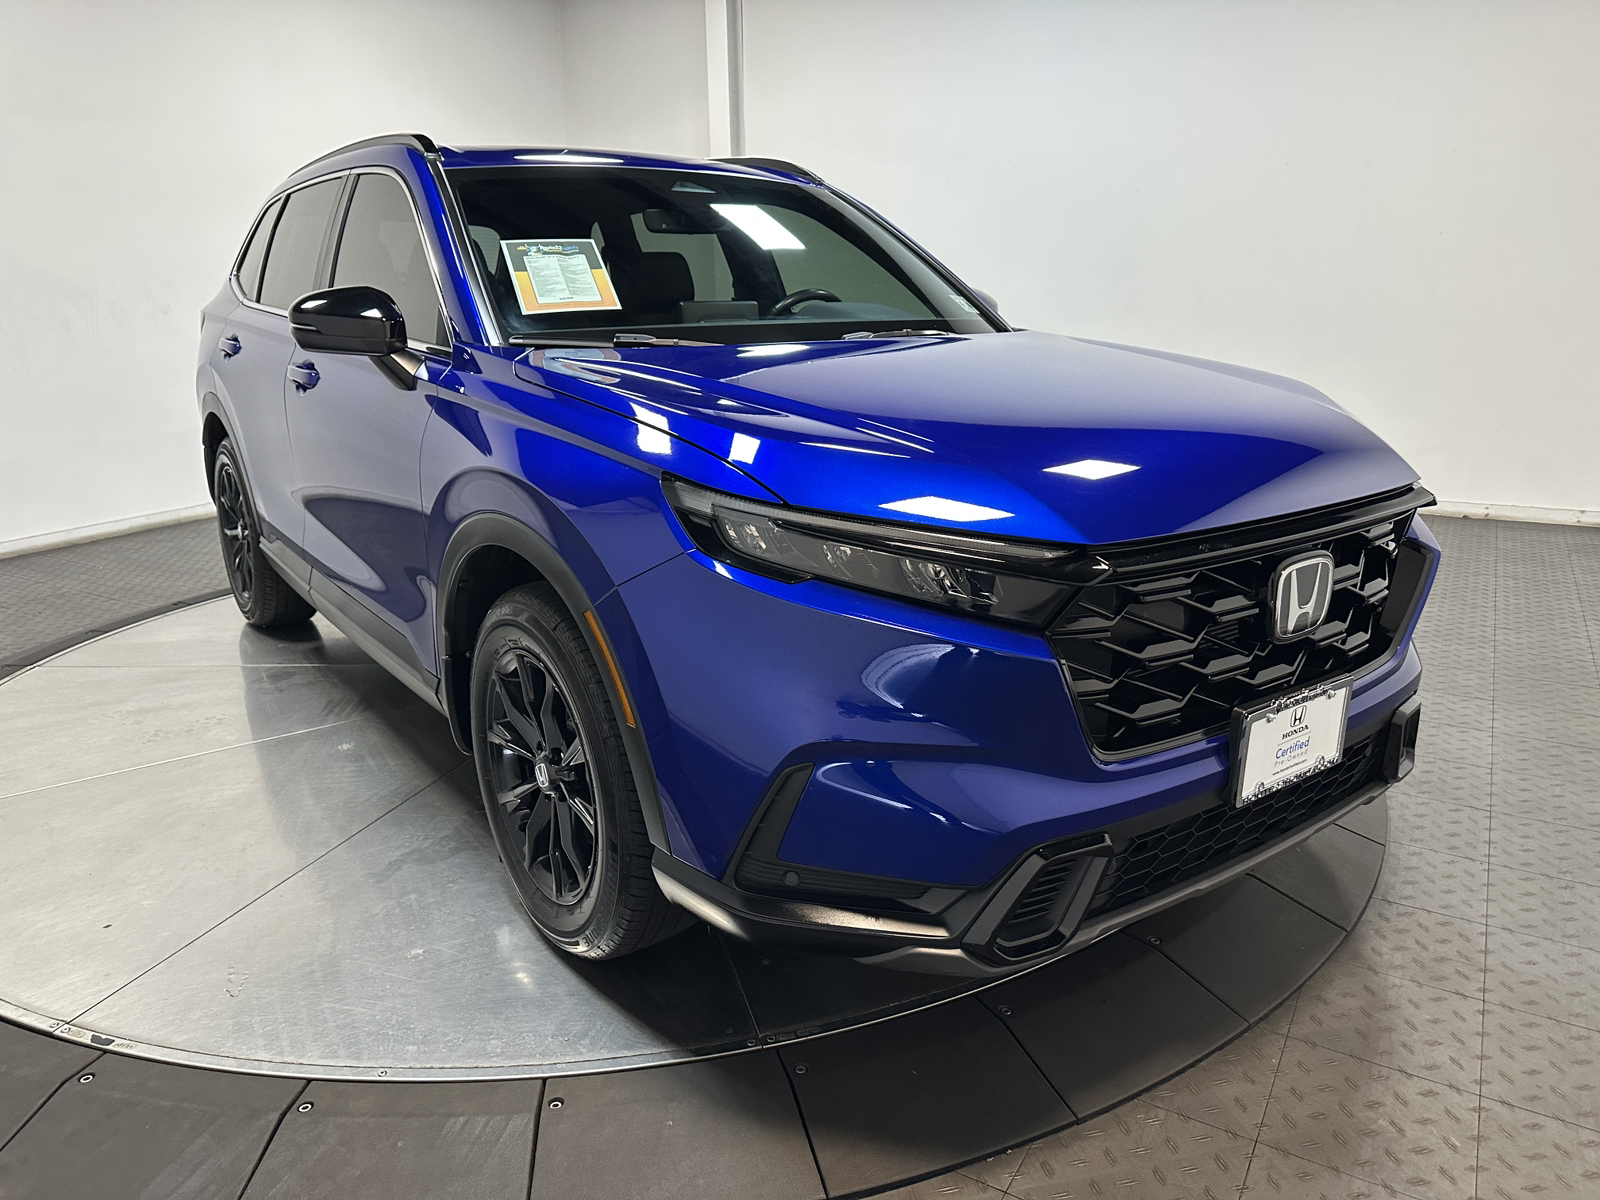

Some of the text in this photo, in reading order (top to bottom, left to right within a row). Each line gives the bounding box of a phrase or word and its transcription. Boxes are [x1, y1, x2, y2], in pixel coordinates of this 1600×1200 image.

[1281, 724, 1309, 740] HONDA
[1275, 736, 1311, 759] Certified
[1274, 749, 1308, 768] Pre-Owned
